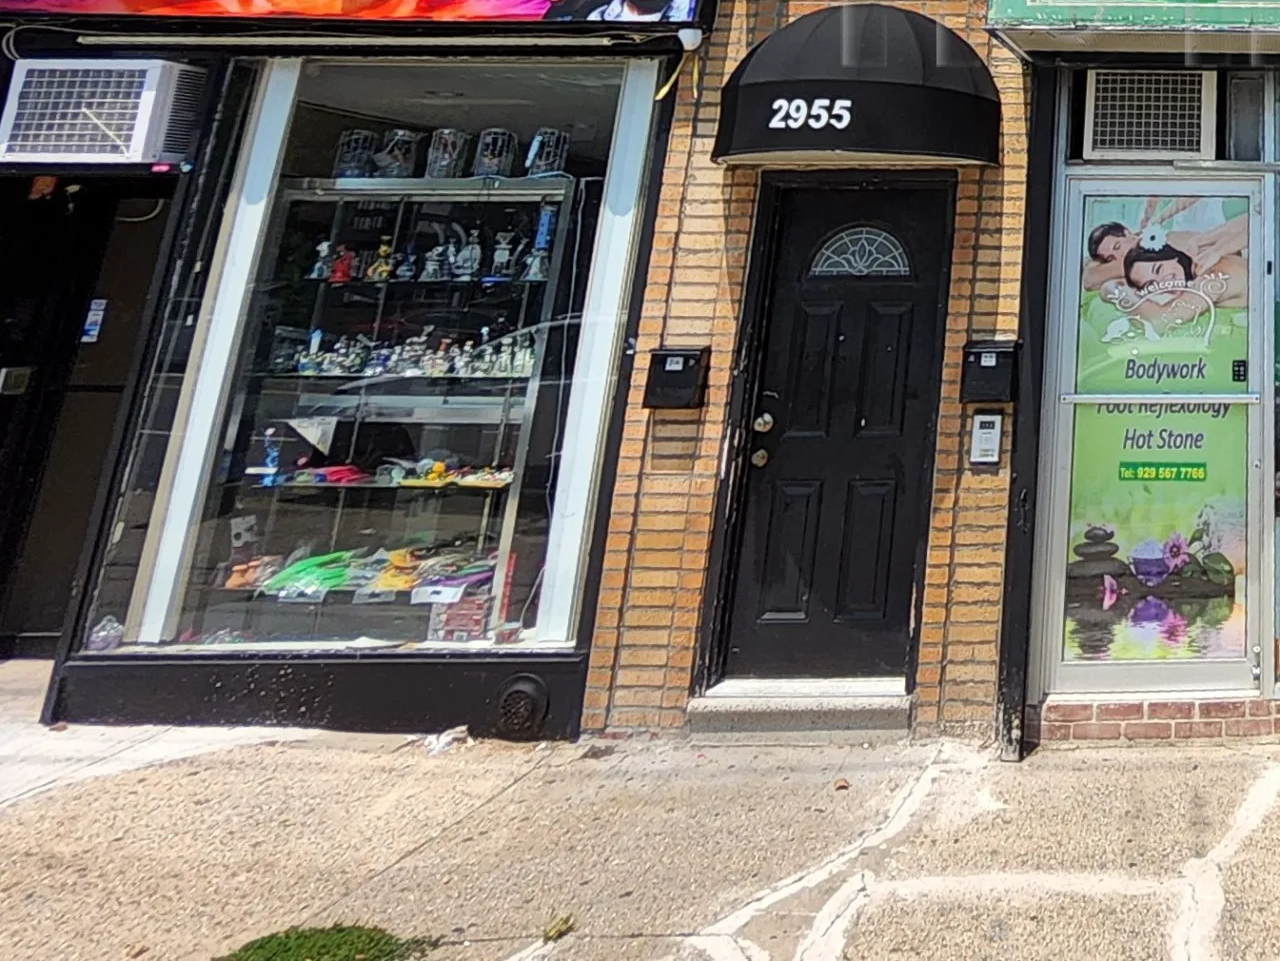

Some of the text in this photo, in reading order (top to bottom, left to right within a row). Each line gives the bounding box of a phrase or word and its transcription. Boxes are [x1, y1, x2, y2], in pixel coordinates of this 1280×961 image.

[767, 97, 852, 131] 2955
[1136, 277, 1195, 298] welcome
[1124, 358, 1206, 382] Bodywork
[1122, 428, 1205, 450] Hot Stone
[1137, 467, 1156, 480] 929
[1158, 467, 1178, 480] 567
[1180, 467, 1205, 480] 7766
